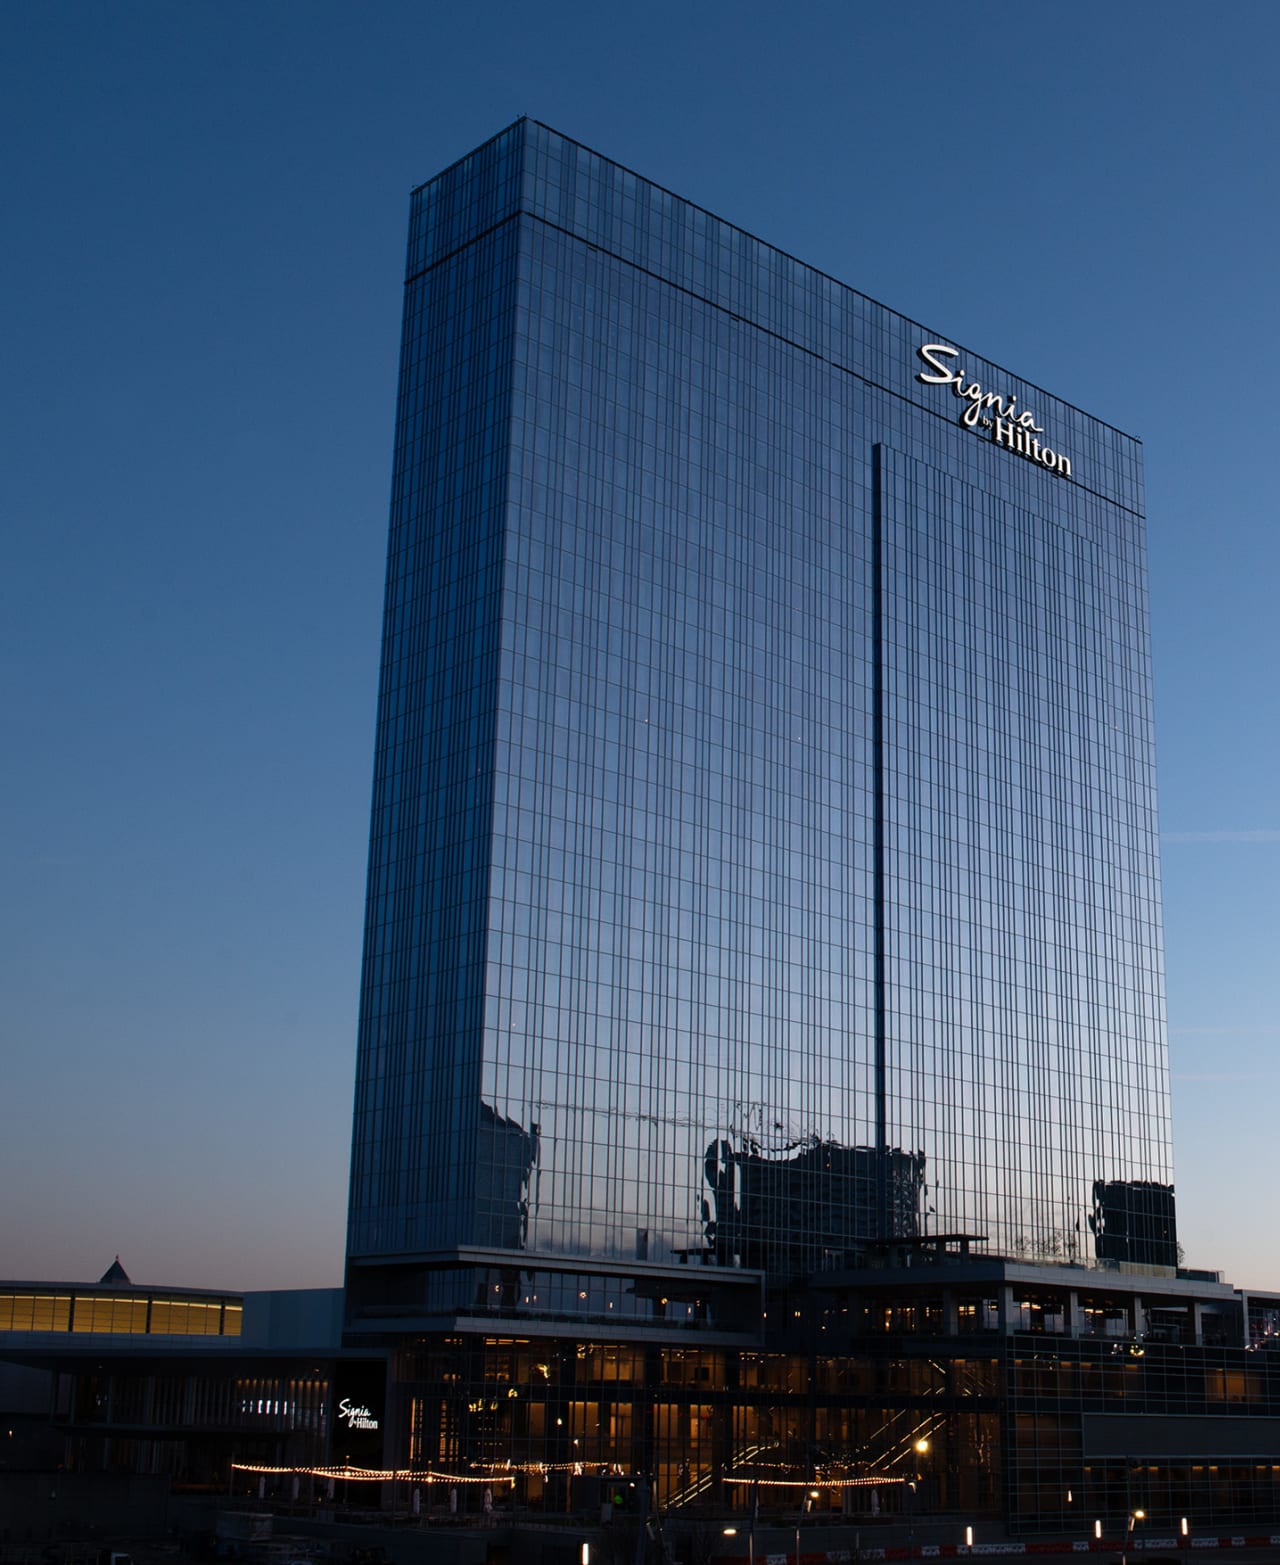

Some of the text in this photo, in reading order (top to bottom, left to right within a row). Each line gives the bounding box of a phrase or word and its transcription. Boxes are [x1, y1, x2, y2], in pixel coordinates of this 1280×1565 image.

[920, 344, 1044, 431] Signia
[982, 415, 1072, 476] by Hilton
[338, 1398, 372, 1428] Signia
[356, 1417, 379, 1429] Hilton
